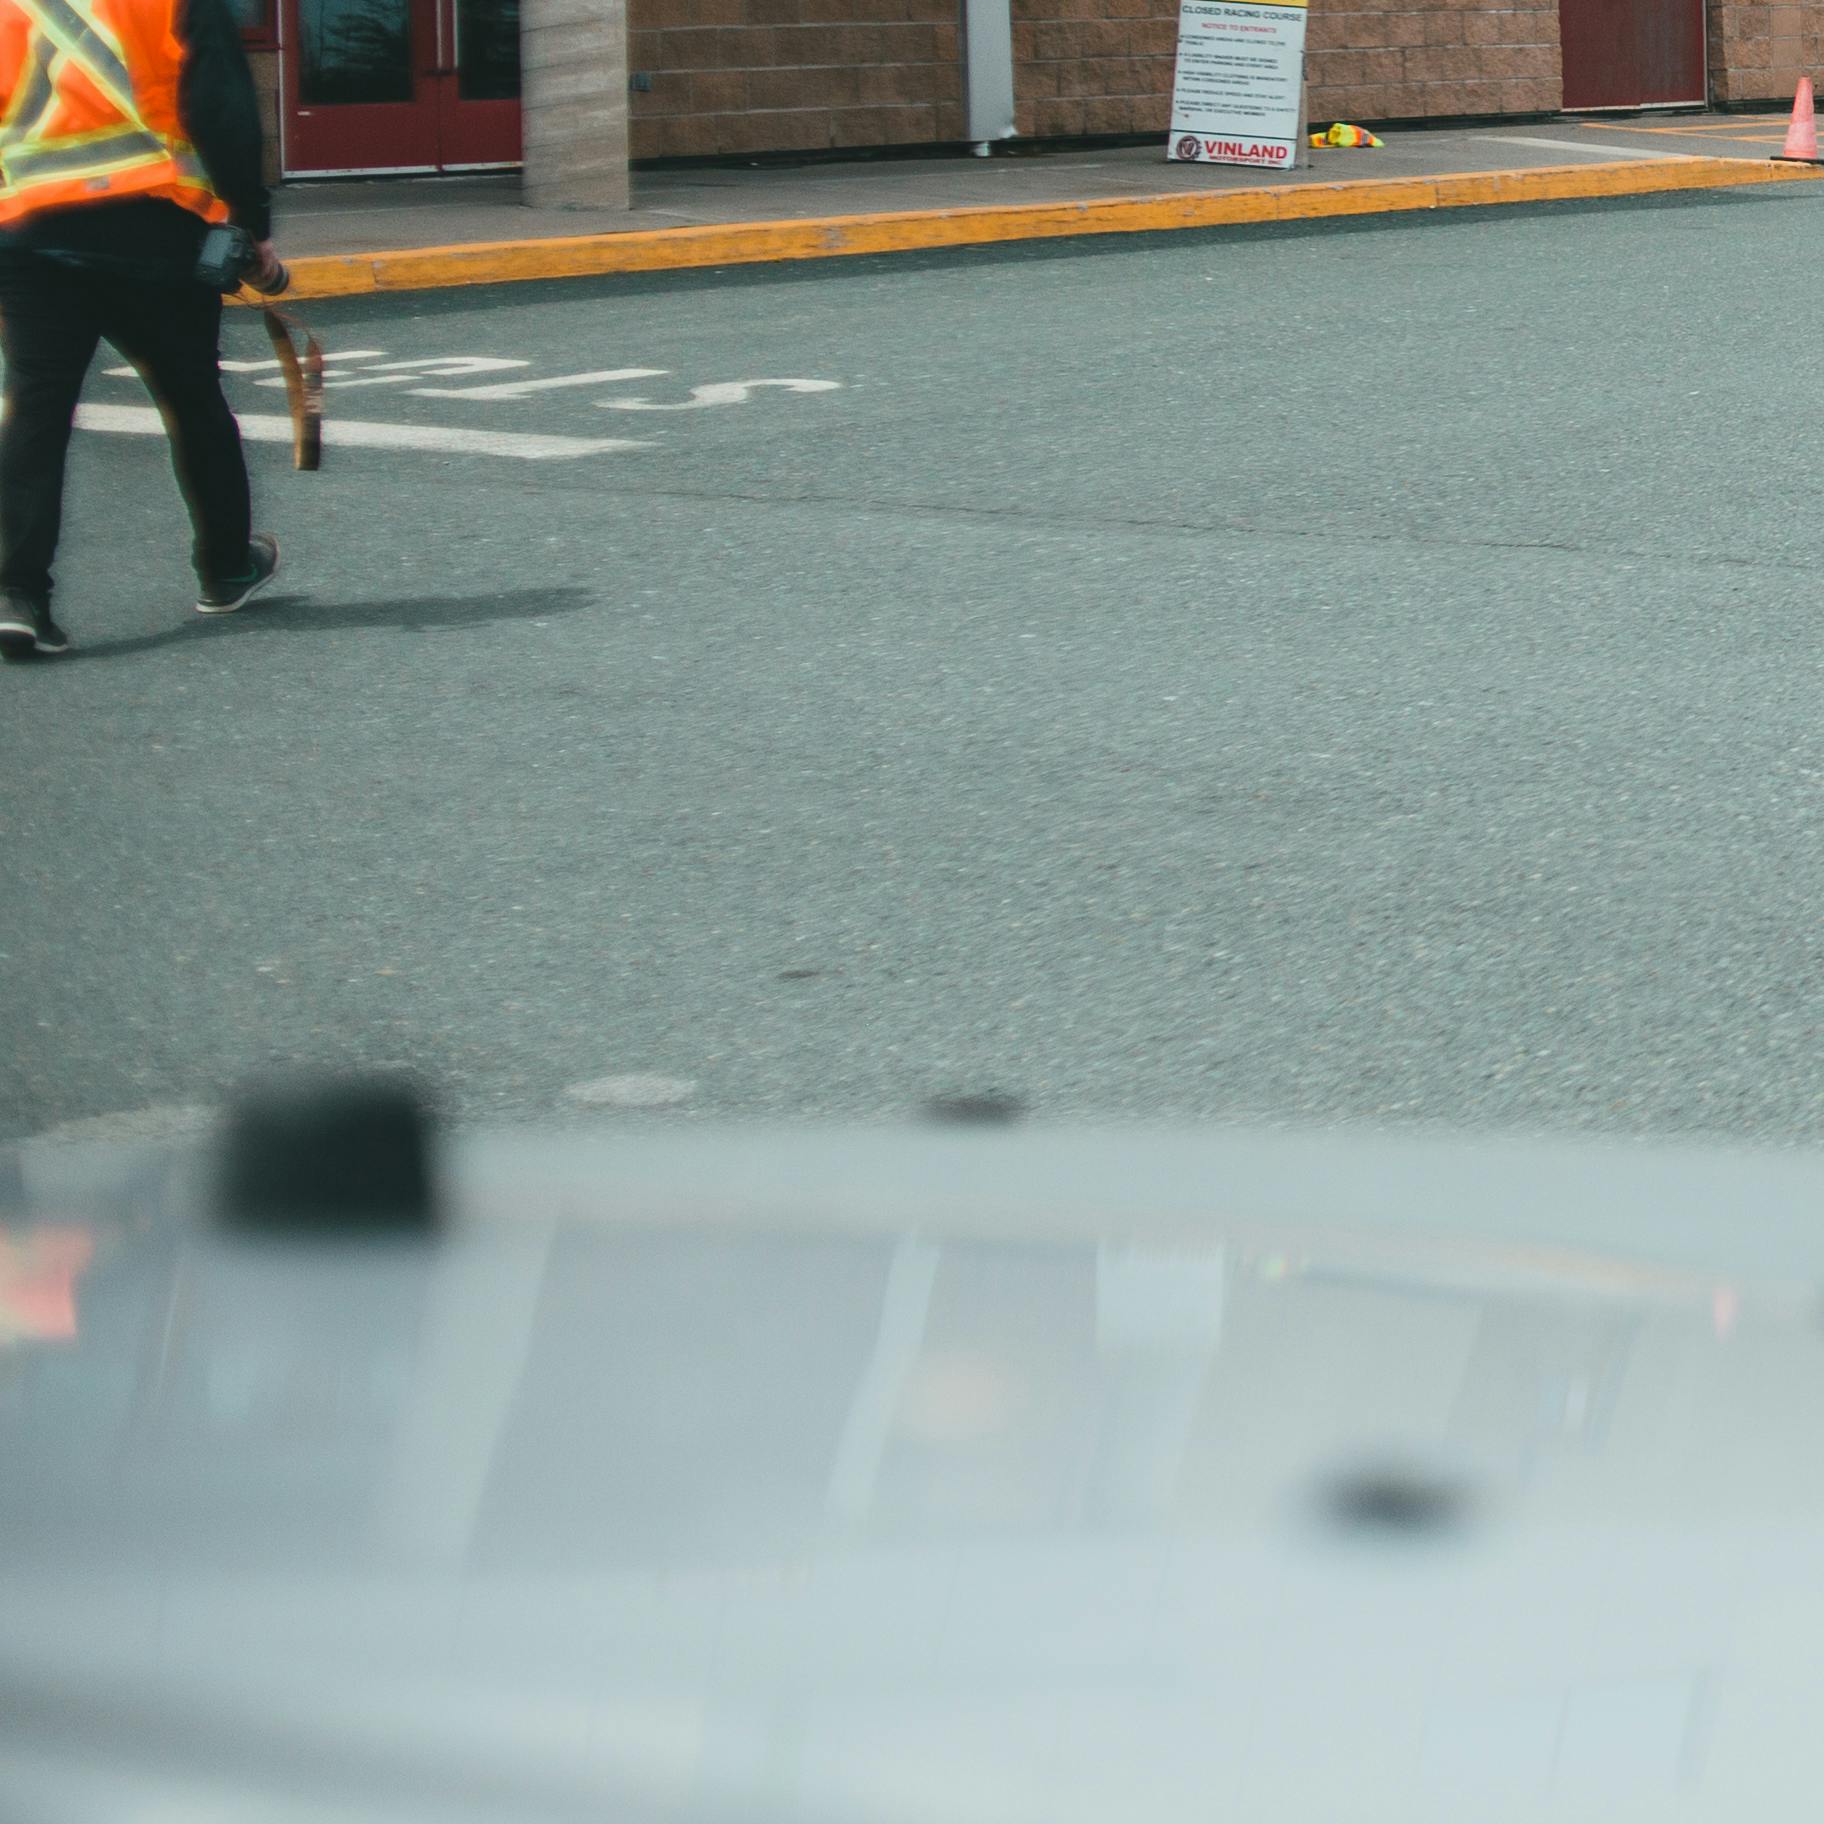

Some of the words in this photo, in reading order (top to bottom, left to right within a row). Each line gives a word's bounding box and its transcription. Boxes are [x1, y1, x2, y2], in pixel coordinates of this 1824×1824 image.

[1182, 5, 1222, 16] CLOSED
[1224, 8, 1261, 18] RACING
[1263, 11, 1303, 22] COURSE
[1204, 140, 1288, 160] VINLAND
